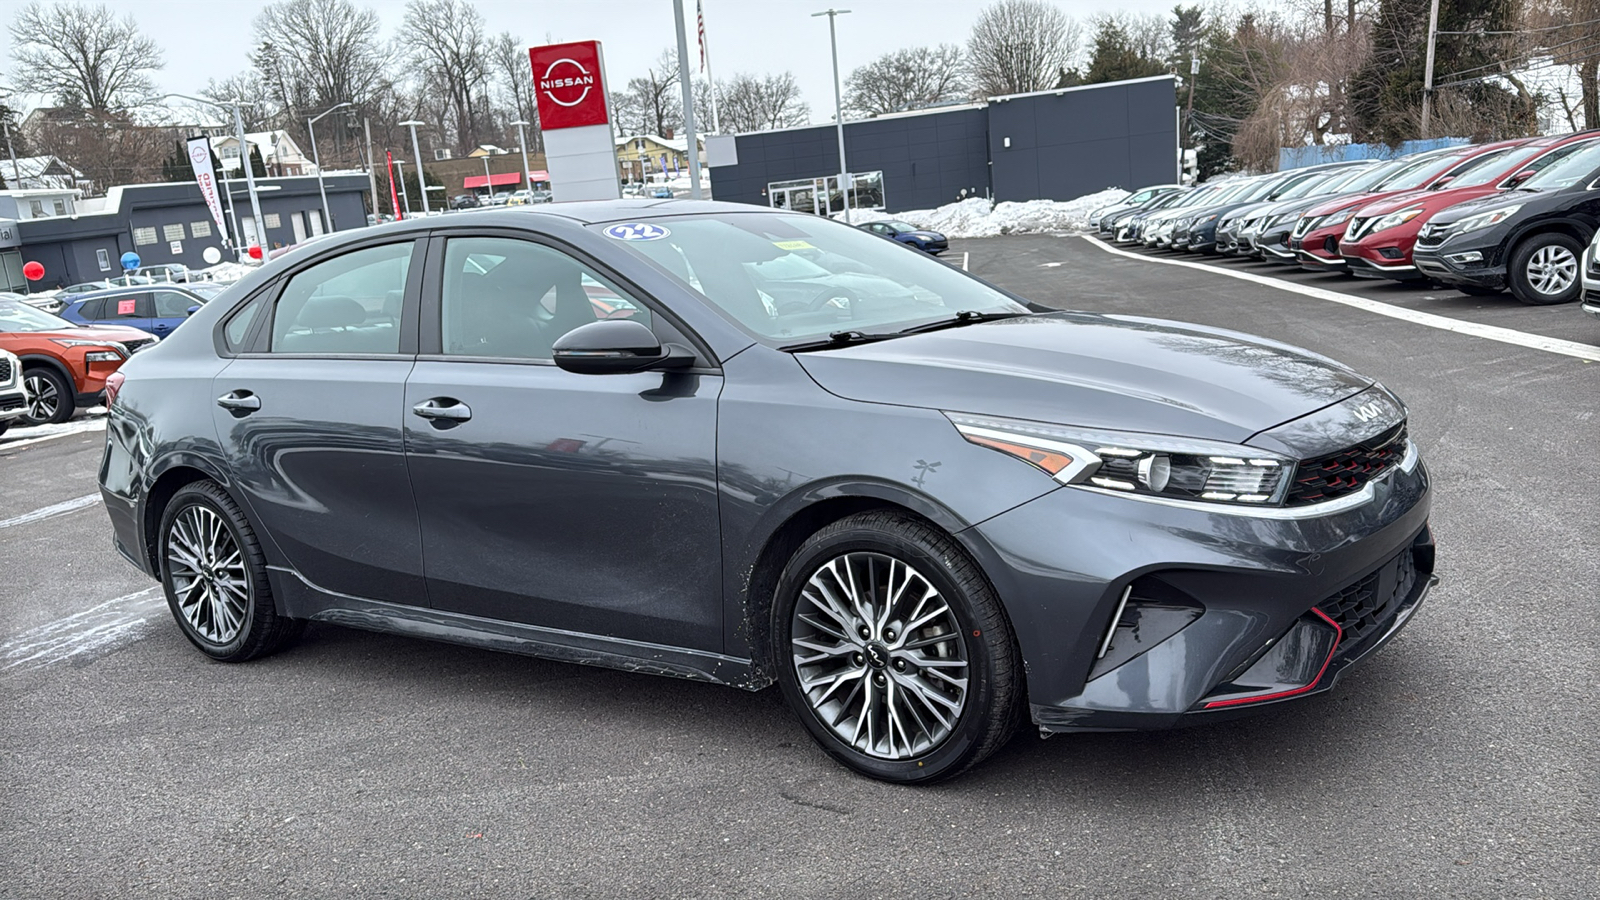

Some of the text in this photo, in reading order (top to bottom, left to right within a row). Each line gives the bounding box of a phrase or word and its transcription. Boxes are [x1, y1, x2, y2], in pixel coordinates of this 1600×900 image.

[540, 75, 593, 90] NISSAN
[615, 223, 662, 239] 22
[1353, 403, 1382, 422] KIA
